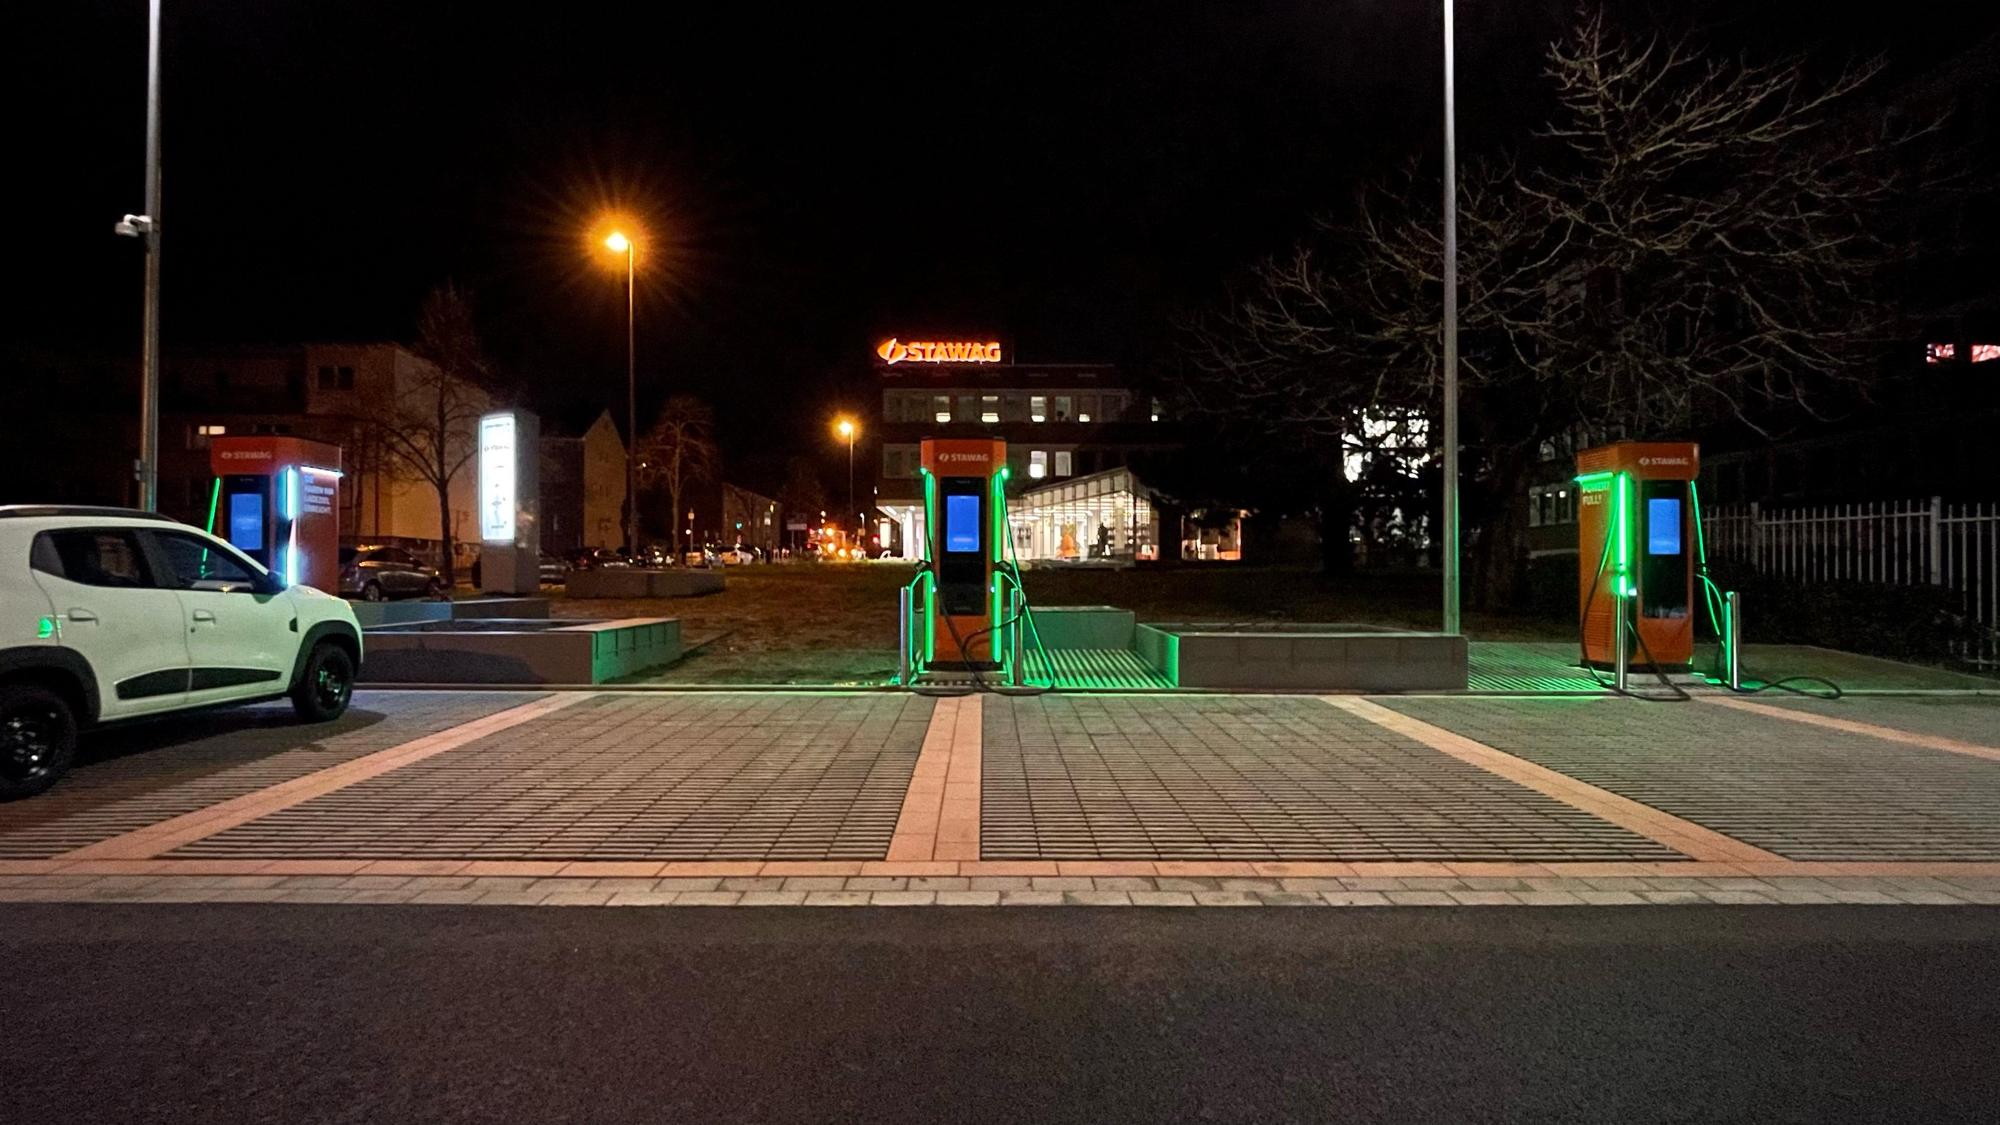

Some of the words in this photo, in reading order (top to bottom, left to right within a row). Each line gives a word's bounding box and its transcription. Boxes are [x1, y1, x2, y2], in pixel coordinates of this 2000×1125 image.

[907, 342, 1001, 362] STAWAG
[950, 452, 989, 462] STAWAG
[1651, 457, 1688, 465] STAWAG
